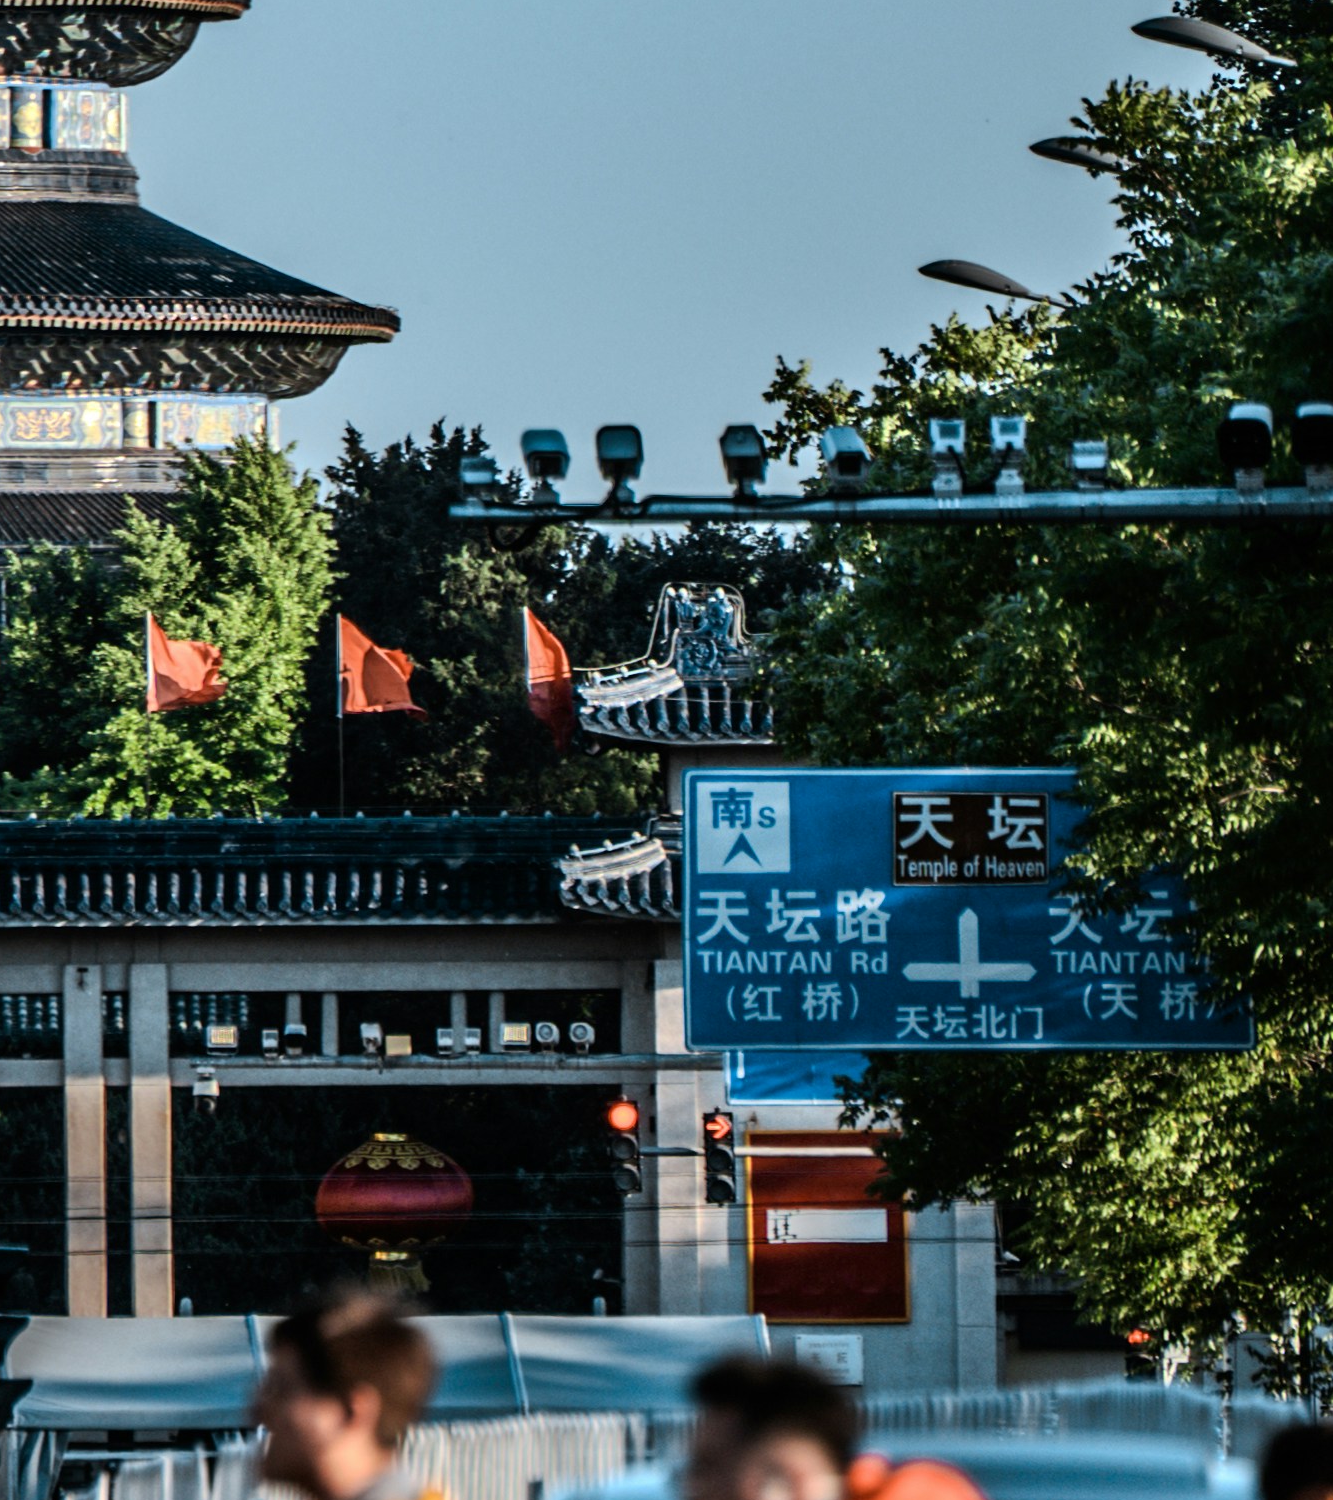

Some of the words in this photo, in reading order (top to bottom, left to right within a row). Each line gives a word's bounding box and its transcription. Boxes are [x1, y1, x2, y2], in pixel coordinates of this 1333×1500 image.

[710, 787, 754, 830] 南
[758, 806, 776, 829] S
[899, 795, 1045, 851] 天坛
[897, 854, 958, 883] Temple
[963, 854, 980, 878] of
[985, 854, 1045, 878] Heaven
[696, 888, 891, 944] 天坛路
[697, 950, 832, 975] TIANTAN
[851, 950, 889, 975] Rd
[1050, 950, 1185, 975] TIANTAN
[895, 1004, 1044, 1040] 天坛北门
